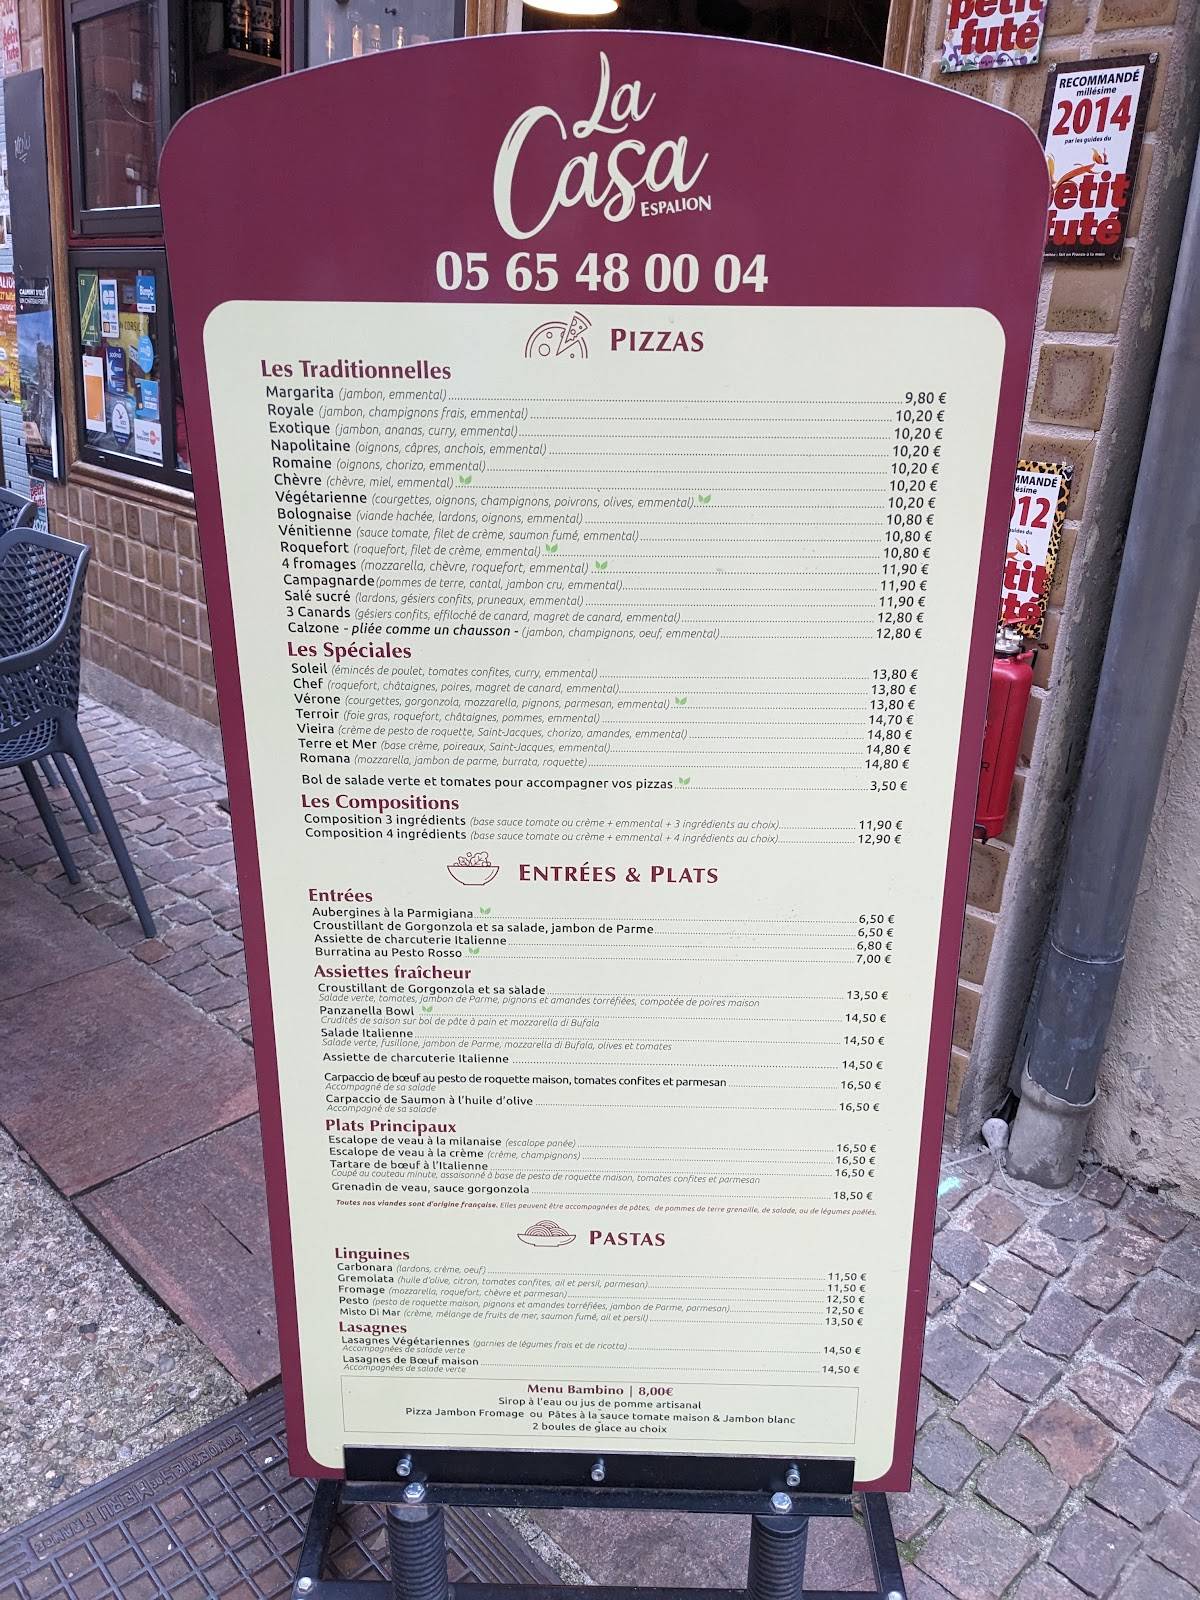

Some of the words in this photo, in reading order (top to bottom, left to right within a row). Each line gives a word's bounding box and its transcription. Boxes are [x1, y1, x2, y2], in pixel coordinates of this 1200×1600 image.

[961, 14, 1039, 55] futé
[1059, 69, 1140, 88] RECOMMANDÉ
[573, 51, 656, 138] La
[1076, 87, 1116, 97] millésime
[1052, 95, 1132, 136] 2014
[493, 106, 709, 240] Casa
[641, 195, 712, 217] ESPALION
[435, 250, 489, 291] 05
[505, 251, 559, 291] 65
[575, 252, 630, 292] 48
[644, 252, 699, 293] 00
[714, 253, 768, 293] 04
[610, 328, 704, 352] PIZZAS
[261, 359, 293, 377] Les
[298, 359, 451, 380] Traditionnelles
[266, 385, 334, 401] Margarita
[338, 386, 385, 401] (jambon,
[388, 388, 447, 402] emmental)
[904, 391, 934, 406] 9,80
[937, 391, 946, 404] €
[273, 472, 322, 486] Chèvre
[326, 474, 366, 488] (chèvre,
[369, 475, 394, 488] miel,
[396, 476, 455, 490] emmental)
[889, 479, 926, 493] 10,20
[929, 479, 937, 491] €
[1011, 495, 1051, 529] 12
[281, 557, 290, 568] 4
[293, 556, 357, 572] fromages
[360, 558, 426, 573] (mozzarella,
[429, 559, 467, 573] chèvre,
[471, 560, 525, 575] roquefort,
[529, 561, 588, 575] emmental)
[882, 563, 917, 577] 11,90
[920, 562, 928, 575] €
[287, 641, 319, 657] Les
[320, 640, 412, 661] Spéciales
[291, 661, 328, 674] Soleil
[330, 664, 375, 677] (émincés
[376, 664, 390, 676] de
[391, 664, 424, 677] poulet,
[428, 666, 468, 676] tomates
[470, 665, 512, 679] confites,
[514, 668, 541, 679] curry,
[544, 666, 598, 680] emmental)
[872, 668, 907, 682] 13,80
[910, 668, 918, 680] €
[301, 773, 323, 784] Bol
[325, 773, 341, 784] de
[344, 773, 384, 786] salade
[387, 775, 420, 786] verte
[423, 776, 437, 786] et
[440, 776, 491, 787] tomates
[494, 778, 524, 790] pour
[526, 779, 609, 790] accompagner
[611, 780, 632, 788] vos
[635, 778, 674, 791] pizzas
[869, 780, 896, 792] 3,50
[899, 780, 908, 791] €
[301, 793, 330, 808] Les
[335, 793, 459, 813] Compositions
[519, 862, 616, 882] ENTRÉES
[625, 867, 640, 882] &
[651, 865, 718, 884] PLATS
[308, 888, 373, 902] Entrées
[311, 906, 381, 919] Aubergines
[383, 906, 390, 917] à
[393, 907, 405, 918] la
[406, 907, 474, 920] Parmigiana
[858, 913, 884, 925] 6,50
[886, 914, 895, 924] €
[313, 964, 389, 978] Assiettes
[393, 965, 471, 979] fraîcheur
[319, 1005, 384, 1016] Panzanella
[385, 1006, 415, 1016] Bowl
[845, 1013, 876, 1024] 14,50
[879, 1013, 887, 1023] €
[325, 1094, 381, 1107] Carpaccio
[383, 1094, 398, 1107] de
[400, 1094, 445, 1105] Saumon
[448, 1094, 455, 1104] à
[458, 1095, 493, 1105] l'huile
[495, 1095, 534, 1106] d'olive
[839, 1102, 870, 1113] 16,50
[872, 1102, 880, 1112] €
[325, 1118, 367, 1132] Plats
[369, 1119, 457, 1136] Principaux
[329, 1146, 378, 1158] Escalope
[381, 1146, 395, 1156] de
[397, 1149, 424, 1157] veau
[427, 1147, 434, 1157] à
[436, 1147, 446, 1157] la
[449, 1147, 484, 1158] crème
[836, 1155, 866, 1166] 16,50
[868, 1156, 875, 1165] €
[589, 1230, 666, 1247] PASTAS
[334, 1247, 410, 1264] Linguines
[338, 1284, 385, 1296] Fromage
[483, 1288, 511, 1297] chèvre
[826, 1294, 856, 1305] 12,50
[857, 1295, 865, 1304] €
[338, 1321, 407, 1337] Lasagnes
[342, 1354, 391, 1366] Lasagnes
[393, 1355, 407, 1367] de
[409, 1355, 439, 1366] Bœuf
[441, 1356, 480, 1365] maison
[821, 1364, 850, 1375] 14,50
[852, 1365, 860, 1374] €
[527, 1383, 563, 1394] Menu
[567, 1384, 624, 1395] Bambino
[636, 1386, 674, 1397] 8,00€
[498, 1396, 526, 1407] Sirop
[528, 1396, 534, 1405] à
[536, 1397, 562, 1406] l'eau
[579, 1398, 595, 1408] jus
[597, 1398, 611, 1407] de
[613, 1400, 653, 1410] pomme
[655, 1400, 701, 1409] artisanal
[33, 1512, 97, 1554] FRANCE
